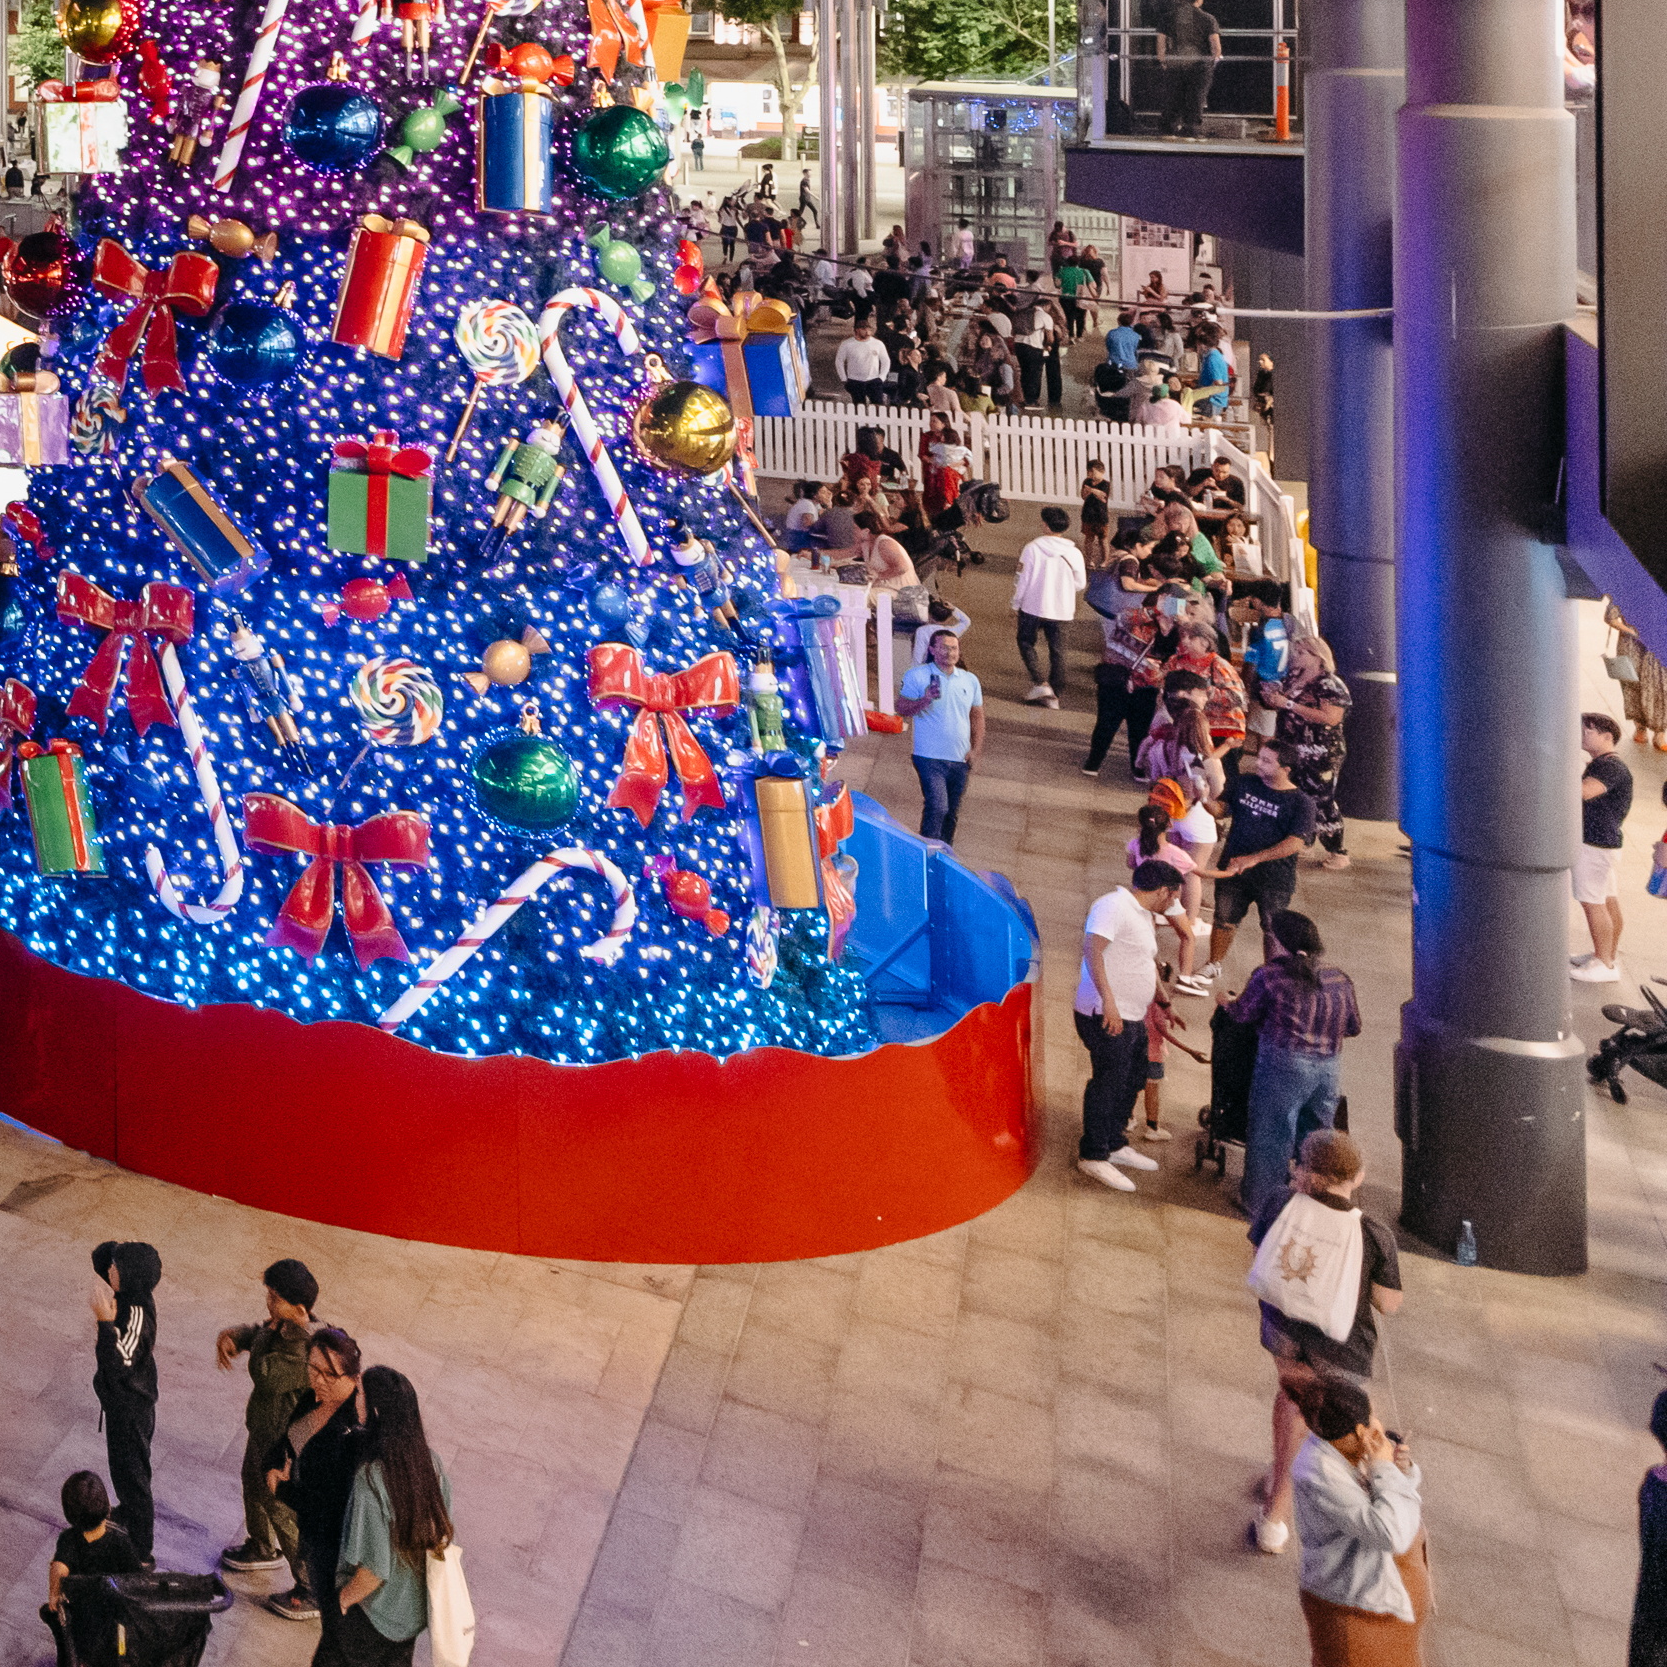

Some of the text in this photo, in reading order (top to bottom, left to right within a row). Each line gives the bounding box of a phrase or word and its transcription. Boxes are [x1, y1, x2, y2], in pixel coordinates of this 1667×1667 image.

[1272, 639, 1289, 673] 7
[1239, 797, 1279, 819] HILFIGER
[1244, 791, 1280, 811] TOMMY
